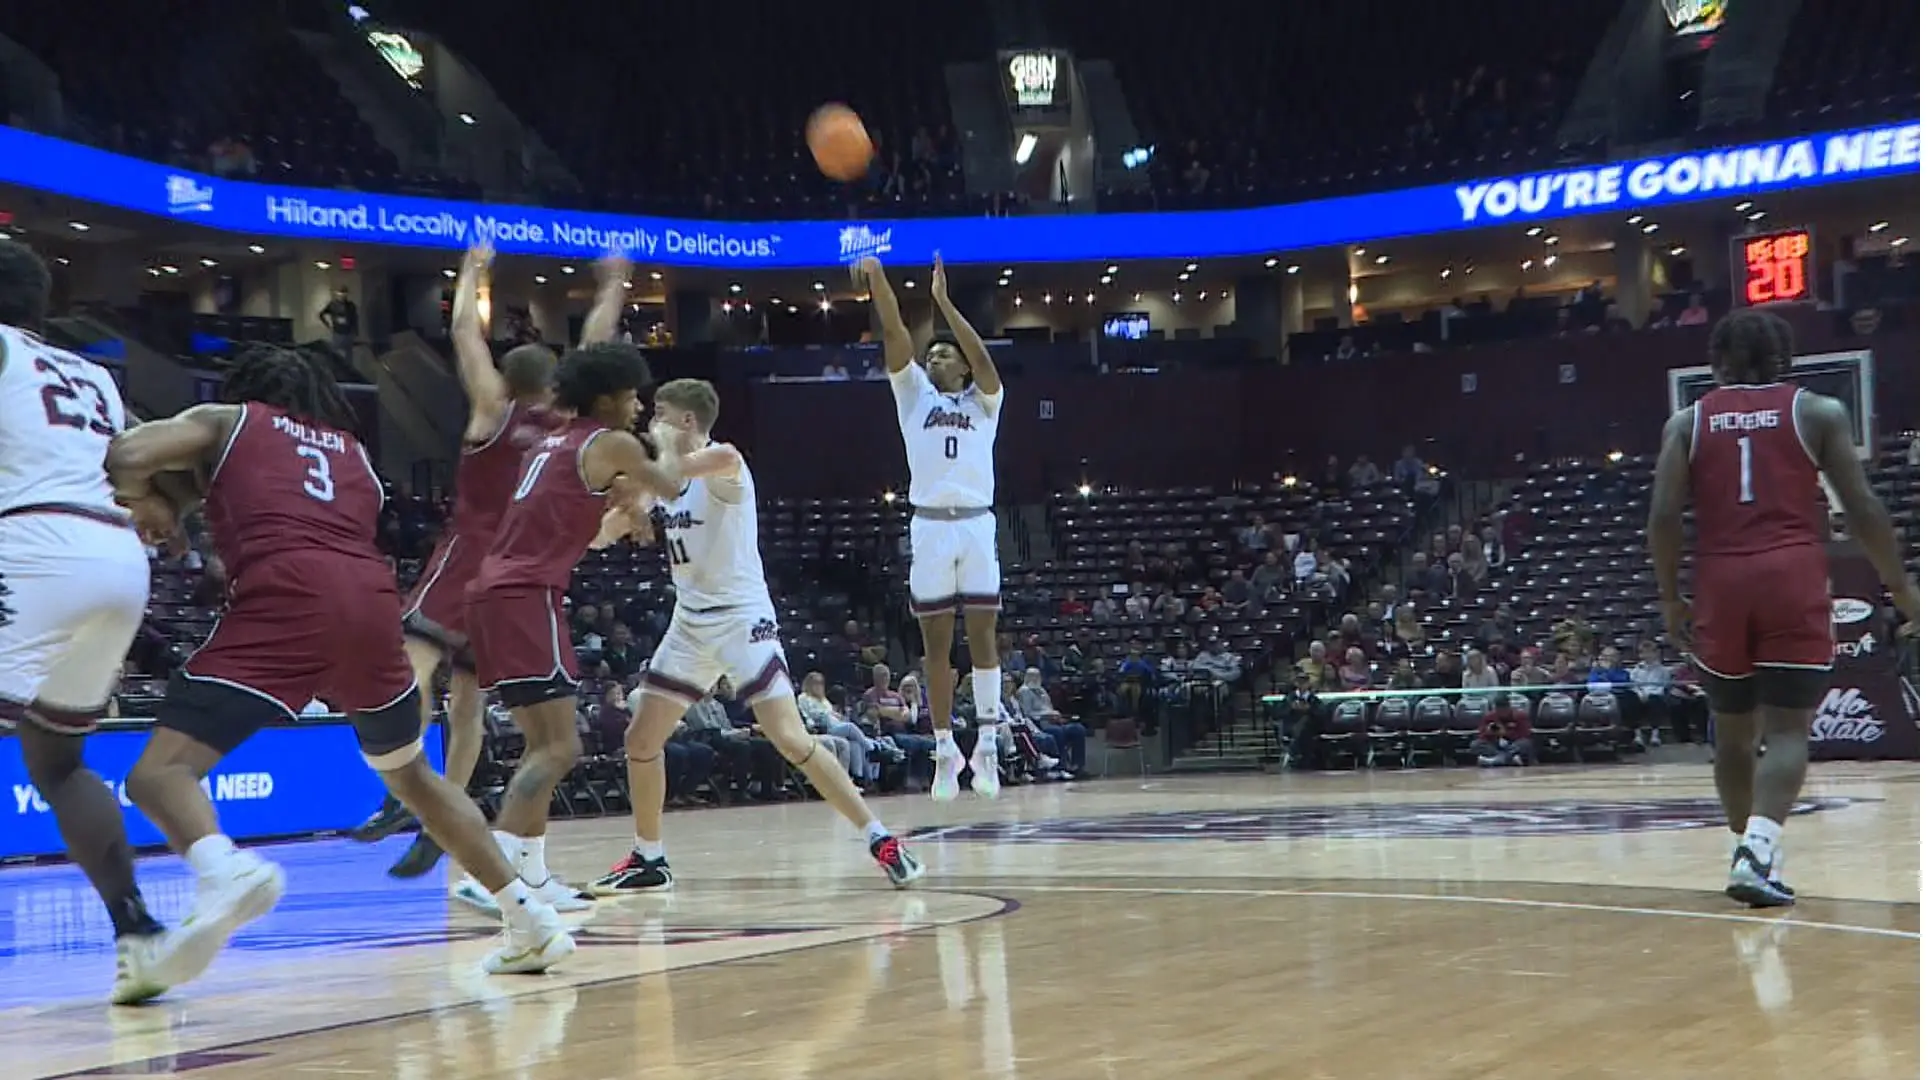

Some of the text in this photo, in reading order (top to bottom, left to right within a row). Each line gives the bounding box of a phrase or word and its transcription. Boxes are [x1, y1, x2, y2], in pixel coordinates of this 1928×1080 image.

[1455, 166, 1625, 221] YOU'RE
[1627, 139, 1815, 200] GONNA
[266, 195, 375, 232] Hiland.
[378, 207, 468, 242] Locally
[474, 214, 550, 244] Made.
[552, 221, 658, 253] Naturally
[1747, 258, 1804, 301] 20
[34, 357, 116, 436] 23
[272, 415, 345, 454] MULLEN
[1709, 410, 1782, 433] PICKENS
[944, 435, 958, 460] 0
[297, 445, 335, 501] 3
[514, 451, 552, 500] 0
[1737, 436, 1754, 502] 1
[669, 537, 691, 565] 11
[1816, 688, 1877, 716] Mo
[1808, 713, 1887, 743] State
[216, 772, 274, 801] NEED
